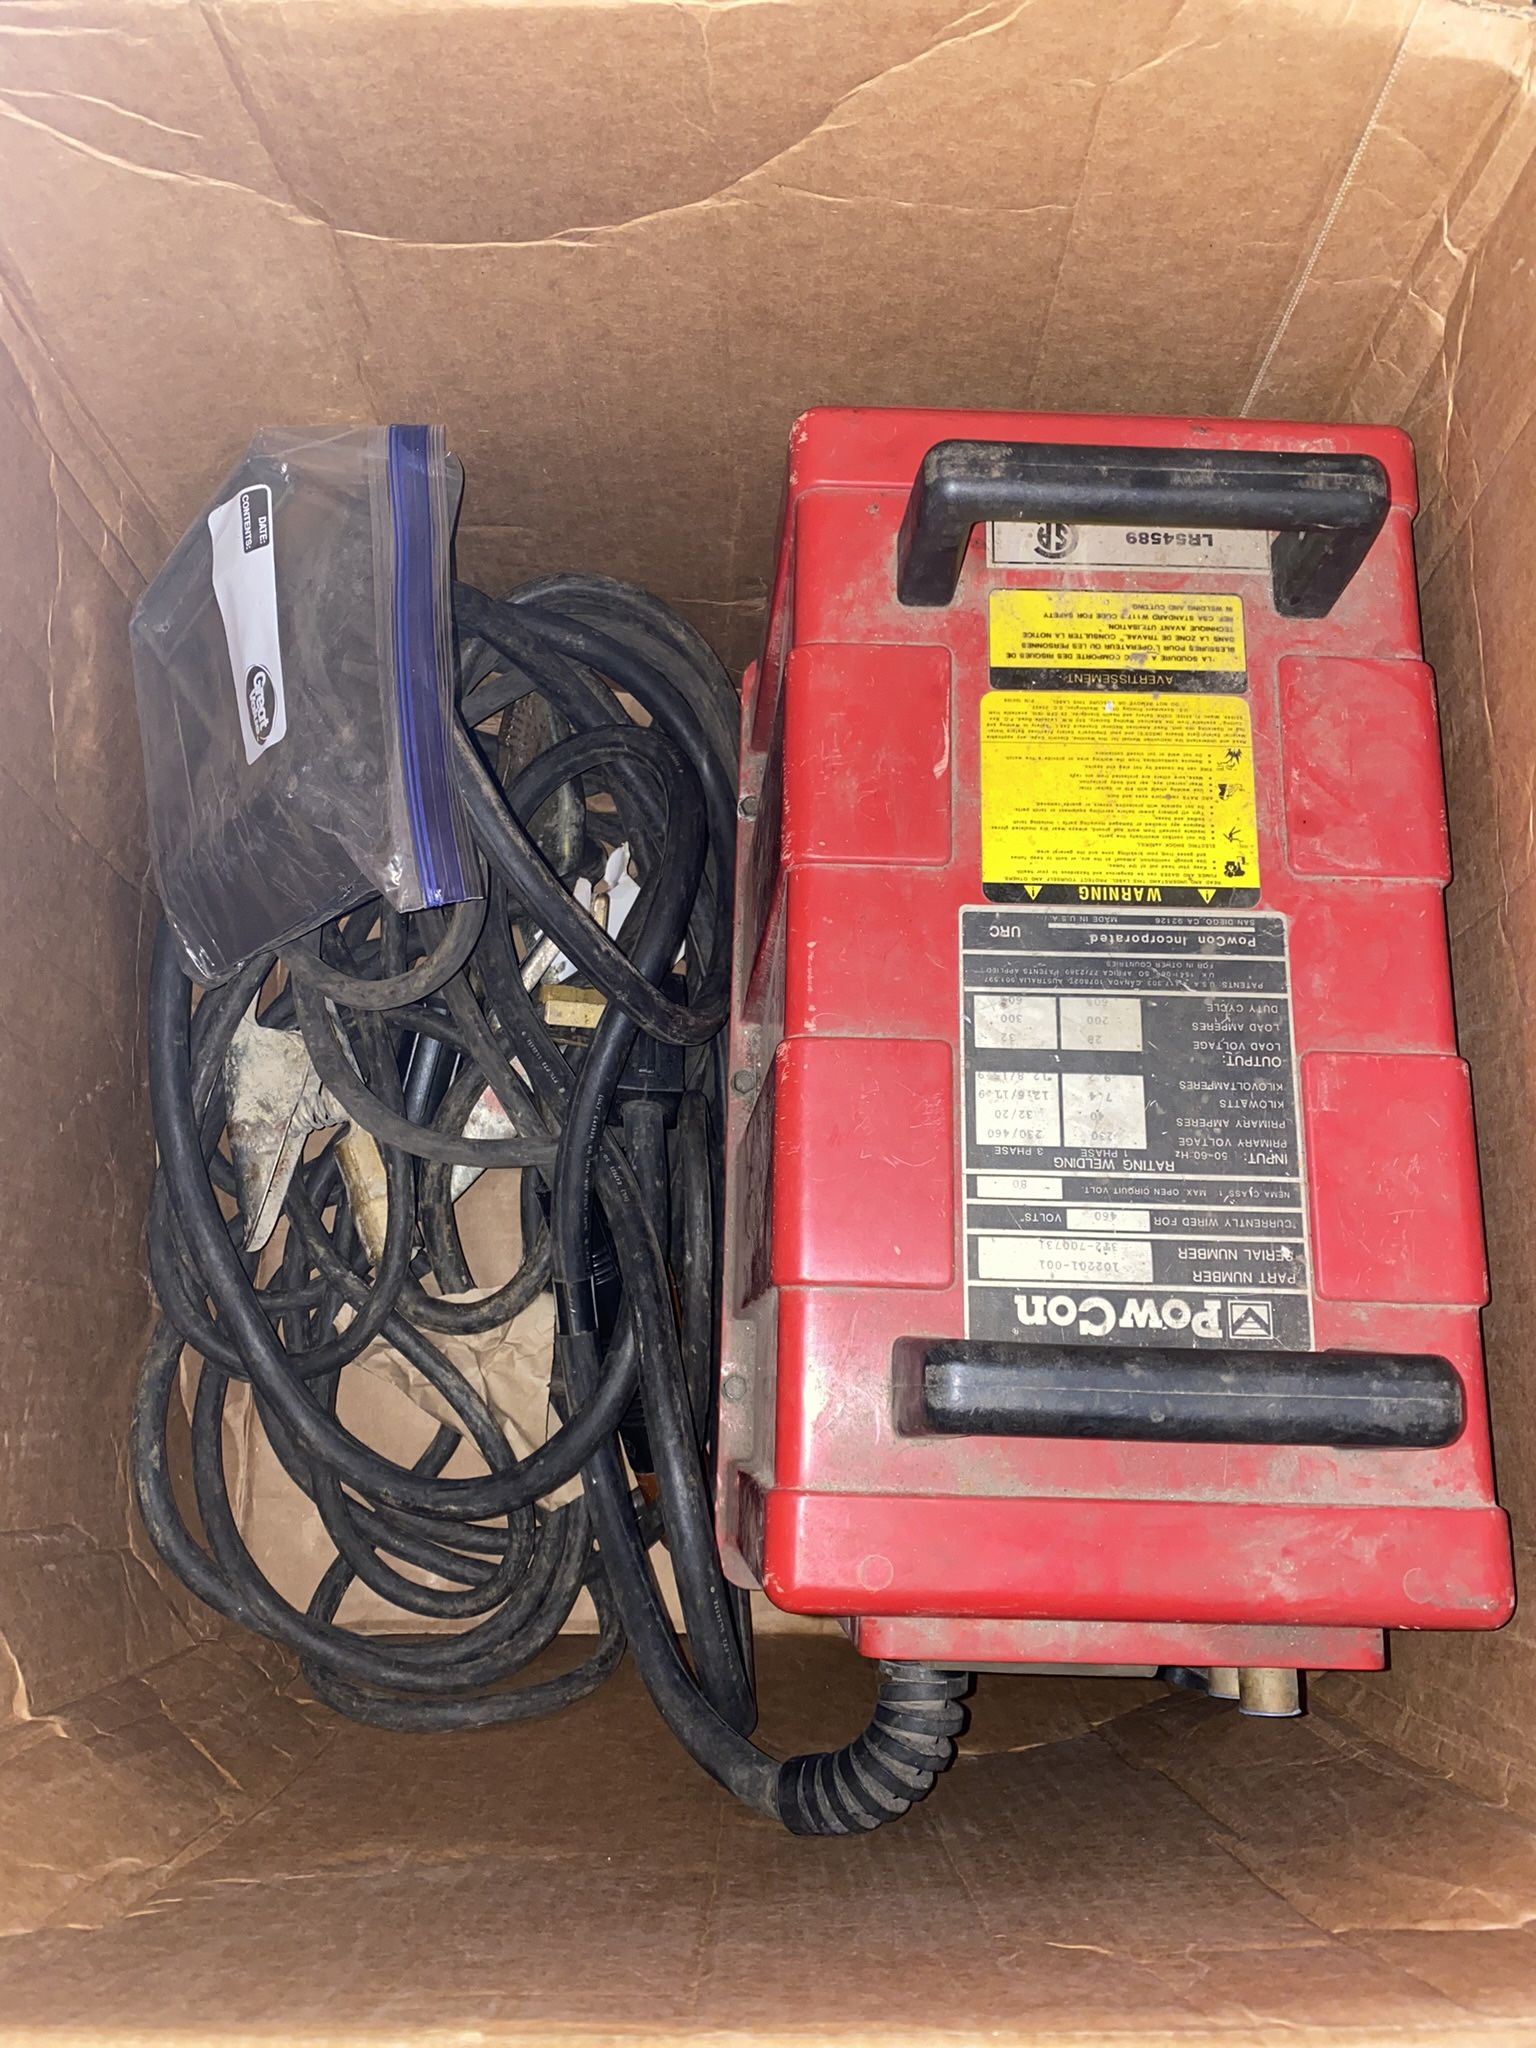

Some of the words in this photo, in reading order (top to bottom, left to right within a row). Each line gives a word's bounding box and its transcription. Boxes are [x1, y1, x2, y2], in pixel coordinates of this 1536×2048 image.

[242, 494, 252, 550] CONTENTS:
[258, 516, 268, 544] DATE:
[1125, 532, 1214, 547] LR54589
[1186, 604, 1222, 612] WELDING
[1152, 614, 1194, 622] STANDARD
[1068, 632, 1116, 640] CONSULTER
[1163, 644, 1186, 652] POUR
[1189, 645, 1235, 653] BLESSURES
[1066, 674, 1174, 685] AVERTISSEMENT
[253, 670, 270, 732] Great
[1078, 886, 1162, 902] WARNING
[1203, 917, 1234, 925] DIEGO,
[1237, 918, 1255, 926] SAN
[989, 925, 1021, 938] URC
[1088, 934, 1186, 946] Incorporated
[1198, 935, 1256, 947] PowCon
[1022, 968, 1059, 976] PATENTS
[1206, 1003, 1244, 1013] CYCLE
[1249, 1004, 1278, 1014] DUTY
[1000, 1014, 1023, 1023] 300
[1086, 1016, 1108, 1025] 200
[1191, 1022, 1244, 1031] AMPERES
[1249, 1023, 1280, 1032] LOAD
[1001, 1032, 1016, 1042] 32
[1087, 1034, 1102, 1044] 28
[1192, 1040, 1245, 1050] VOLTAGE
[1250, 1042, 1281, 1051] LOAD
[1222, 1055, 1282, 1068] OUTPUT:
[1178, 1080, 1284, 1092] KILOVOLTAMPERES
[1088, 1092, 1112, 1102] 7.4
[1219, 1099, 1284, 1108] KILOWATTS
[994, 1109, 1033, 1119] 32/20
[1176, 1117, 1230, 1128] AMPERES
[1235, 1119, 1286, 1129] PRIMARY
[987, 1128, 1043, 1139] 230/460
[1091, 1131, 1114, 1141] 230
[1178, 1137, 1232, 1147] VOLTAGE
[1238, 1138, 1287, 1148] PRIMARY
[994, 1146, 1032, 1155] PHASE
[1036, 1147, 1044, 1156] 3
[1080, 1148, 1118, 1158] PHASE
[1124, 1149, 1128, 1158] 1
[1174, 1150, 1189, 1159] Hz
[1194, 1150, 1228, 1160] 50-60
[1053, 1157, 1115, 1170] WELDING
[1243, 1152, 1288, 1165] INPUT:
[1122, 1159, 1175, 1172] RATING
[1012, 1179, 1028, 1189] 80
[1081, 1186, 1108, 1194] VOLT.
[1113, 1186, 1150, 1196] CIRCUIT
[1153, 1188, 1179, 1196] OPEN
[1228, 1190, 1260, 1198] CLASS
[1094, 1211, 1117, 1222] 460
[1153, 1216, 1177, 1226] FOR
[1182, 1217, 1218, 1227] WIRED
[1178, 1248, 1238, 1260] NUMBER
[1243, 1249, 1294, 1262] SERIAL
[1039, 1260, 1119, 1273] 102201-001
[1192, 1271, 1252, 1282] NUMBER
[1258, 1272, 1296, 1284] PART
[1014, 1294, 1223, 1339] PowCon
